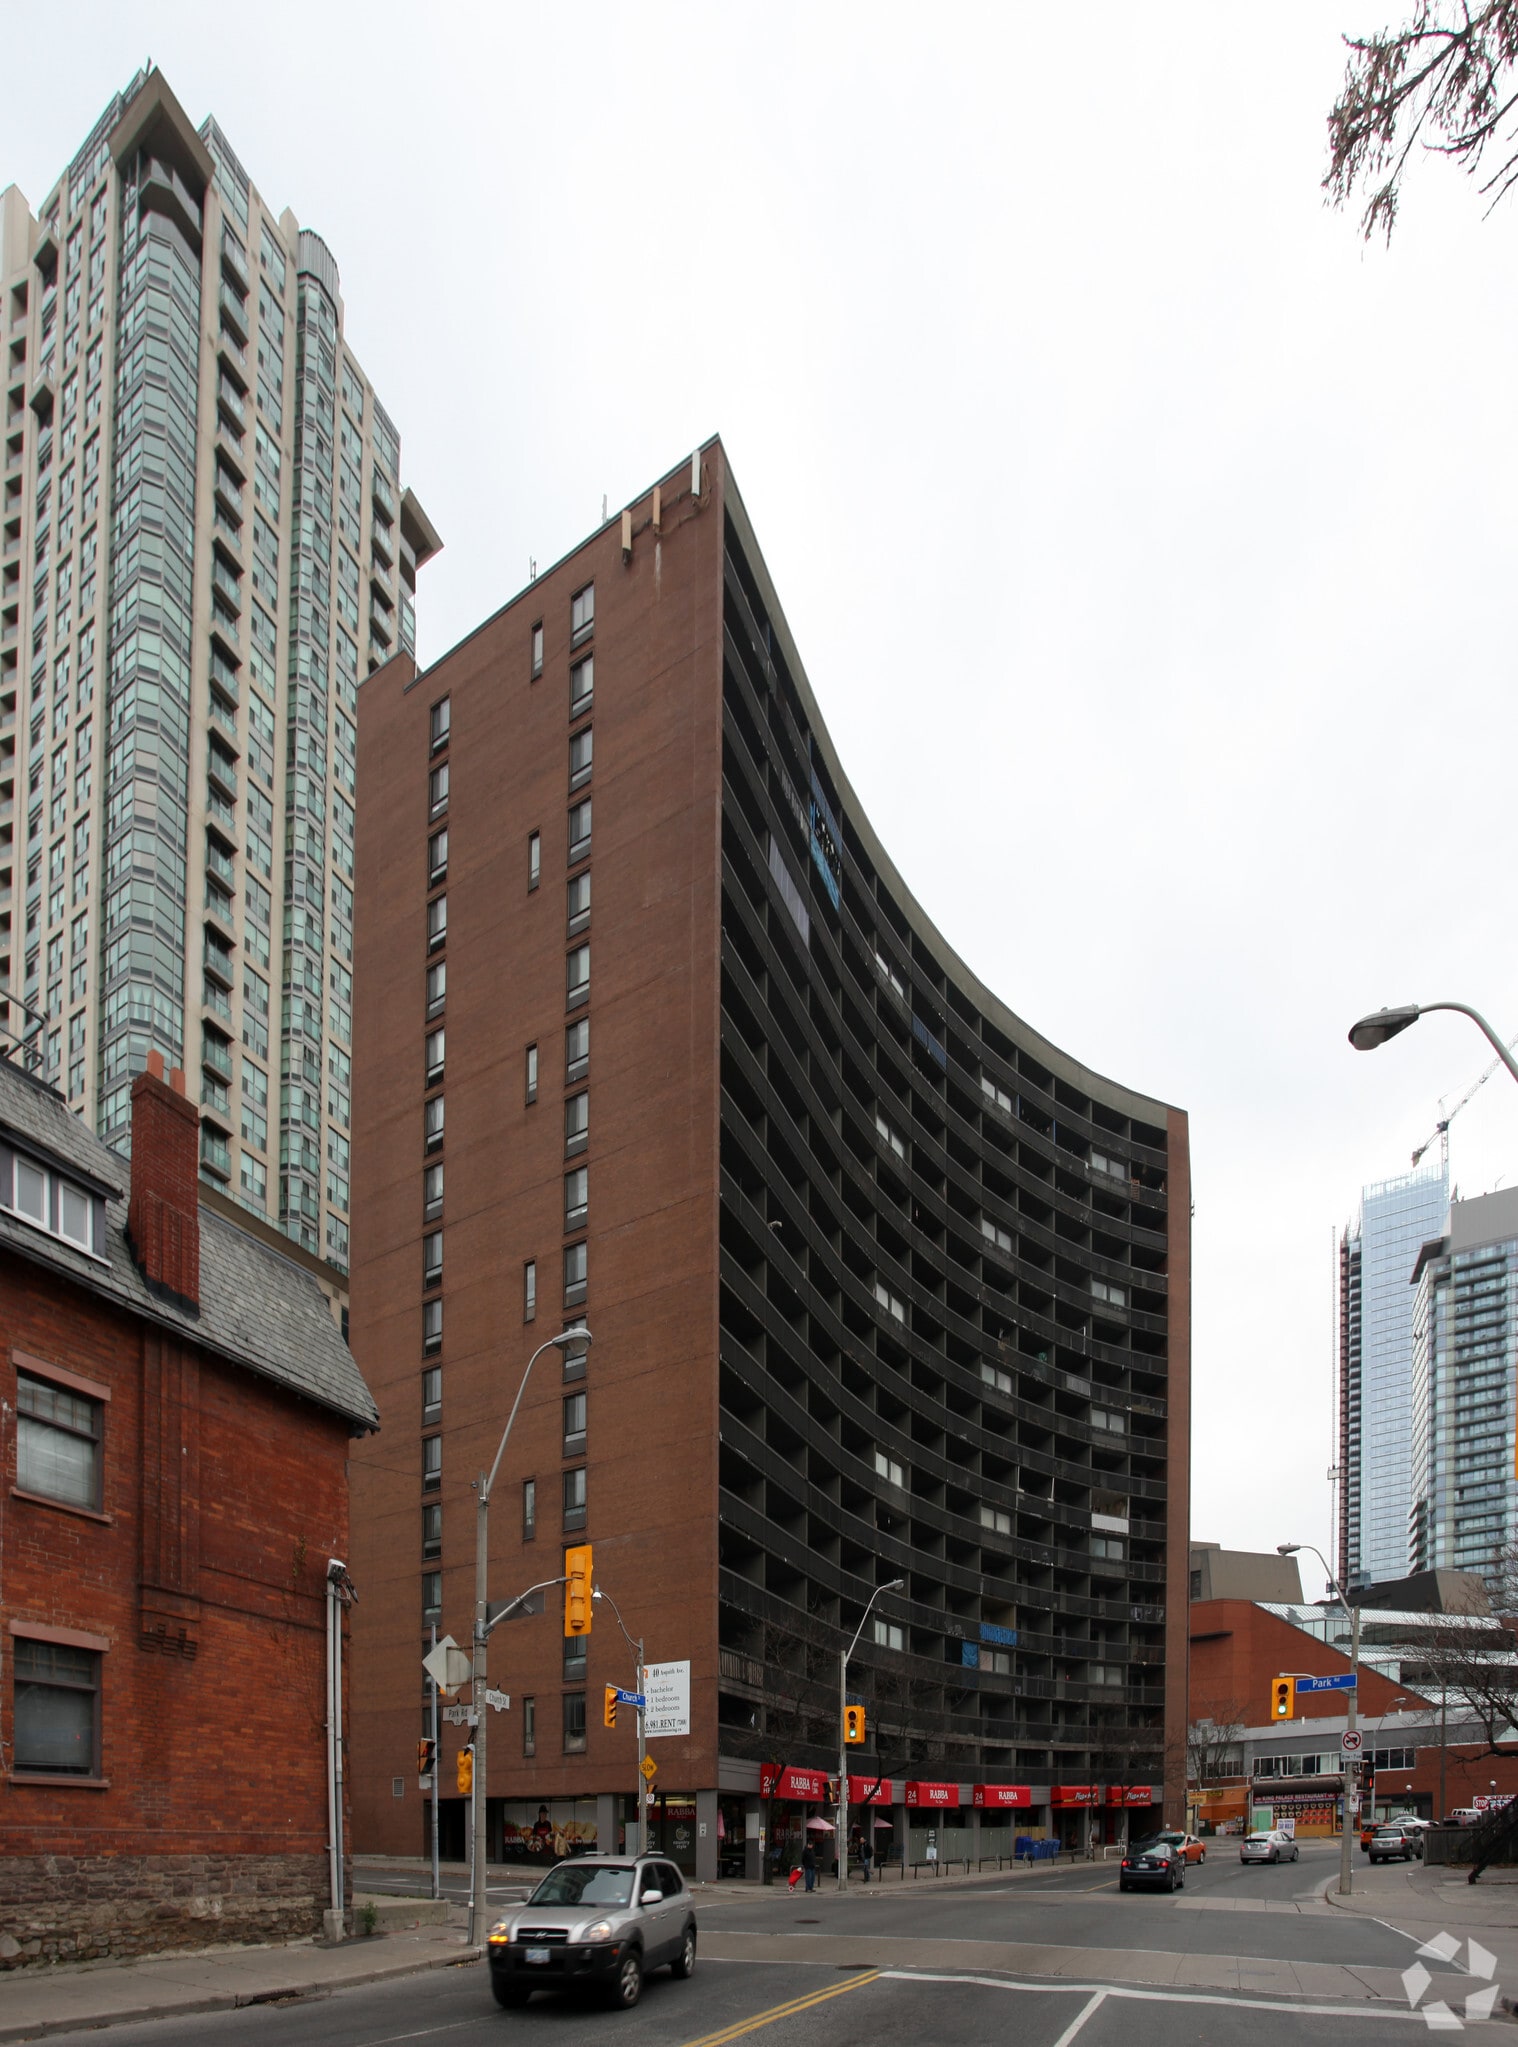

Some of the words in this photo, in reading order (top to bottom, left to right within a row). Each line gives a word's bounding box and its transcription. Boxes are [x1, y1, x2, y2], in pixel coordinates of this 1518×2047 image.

[653, 1668, 660, 1678] 40
[1312, 1678, 1332, 1689] Park
[650, 1685, 674, 1694] bachelor
[489, 1692, 502, 1703] Church
[622, 1692, 638, 1703] Church
[655, 1695, 680, 1703] bedroom
[448, 1709, 459, 1718] Park
[461, 1708, 468, 1717] Rd
[655, 1705, 680, 1713] bedroom
[641, 1763, 654, 1772] SLOW
[790, 1776, 810, 1790] RABBA
[908, 1791, 917, 1799] 24
[929, 1789, 949, 1800] RABBA
[975, 1792, 983, 1800] 24
[998, 1791, 1018, 1800] RABBA
[1075, 1792, 1087, 1801] Pizza
[1127, 1792, 1139, 1800] Pizza
[1140, 1791, 1150, 1799] Hut
[1275, 1793, 1294, 1801] PALACE
[1295, 1792, 1327, 1800] RESTAURANT
[667, 1807, 696, 1816] RABBA
